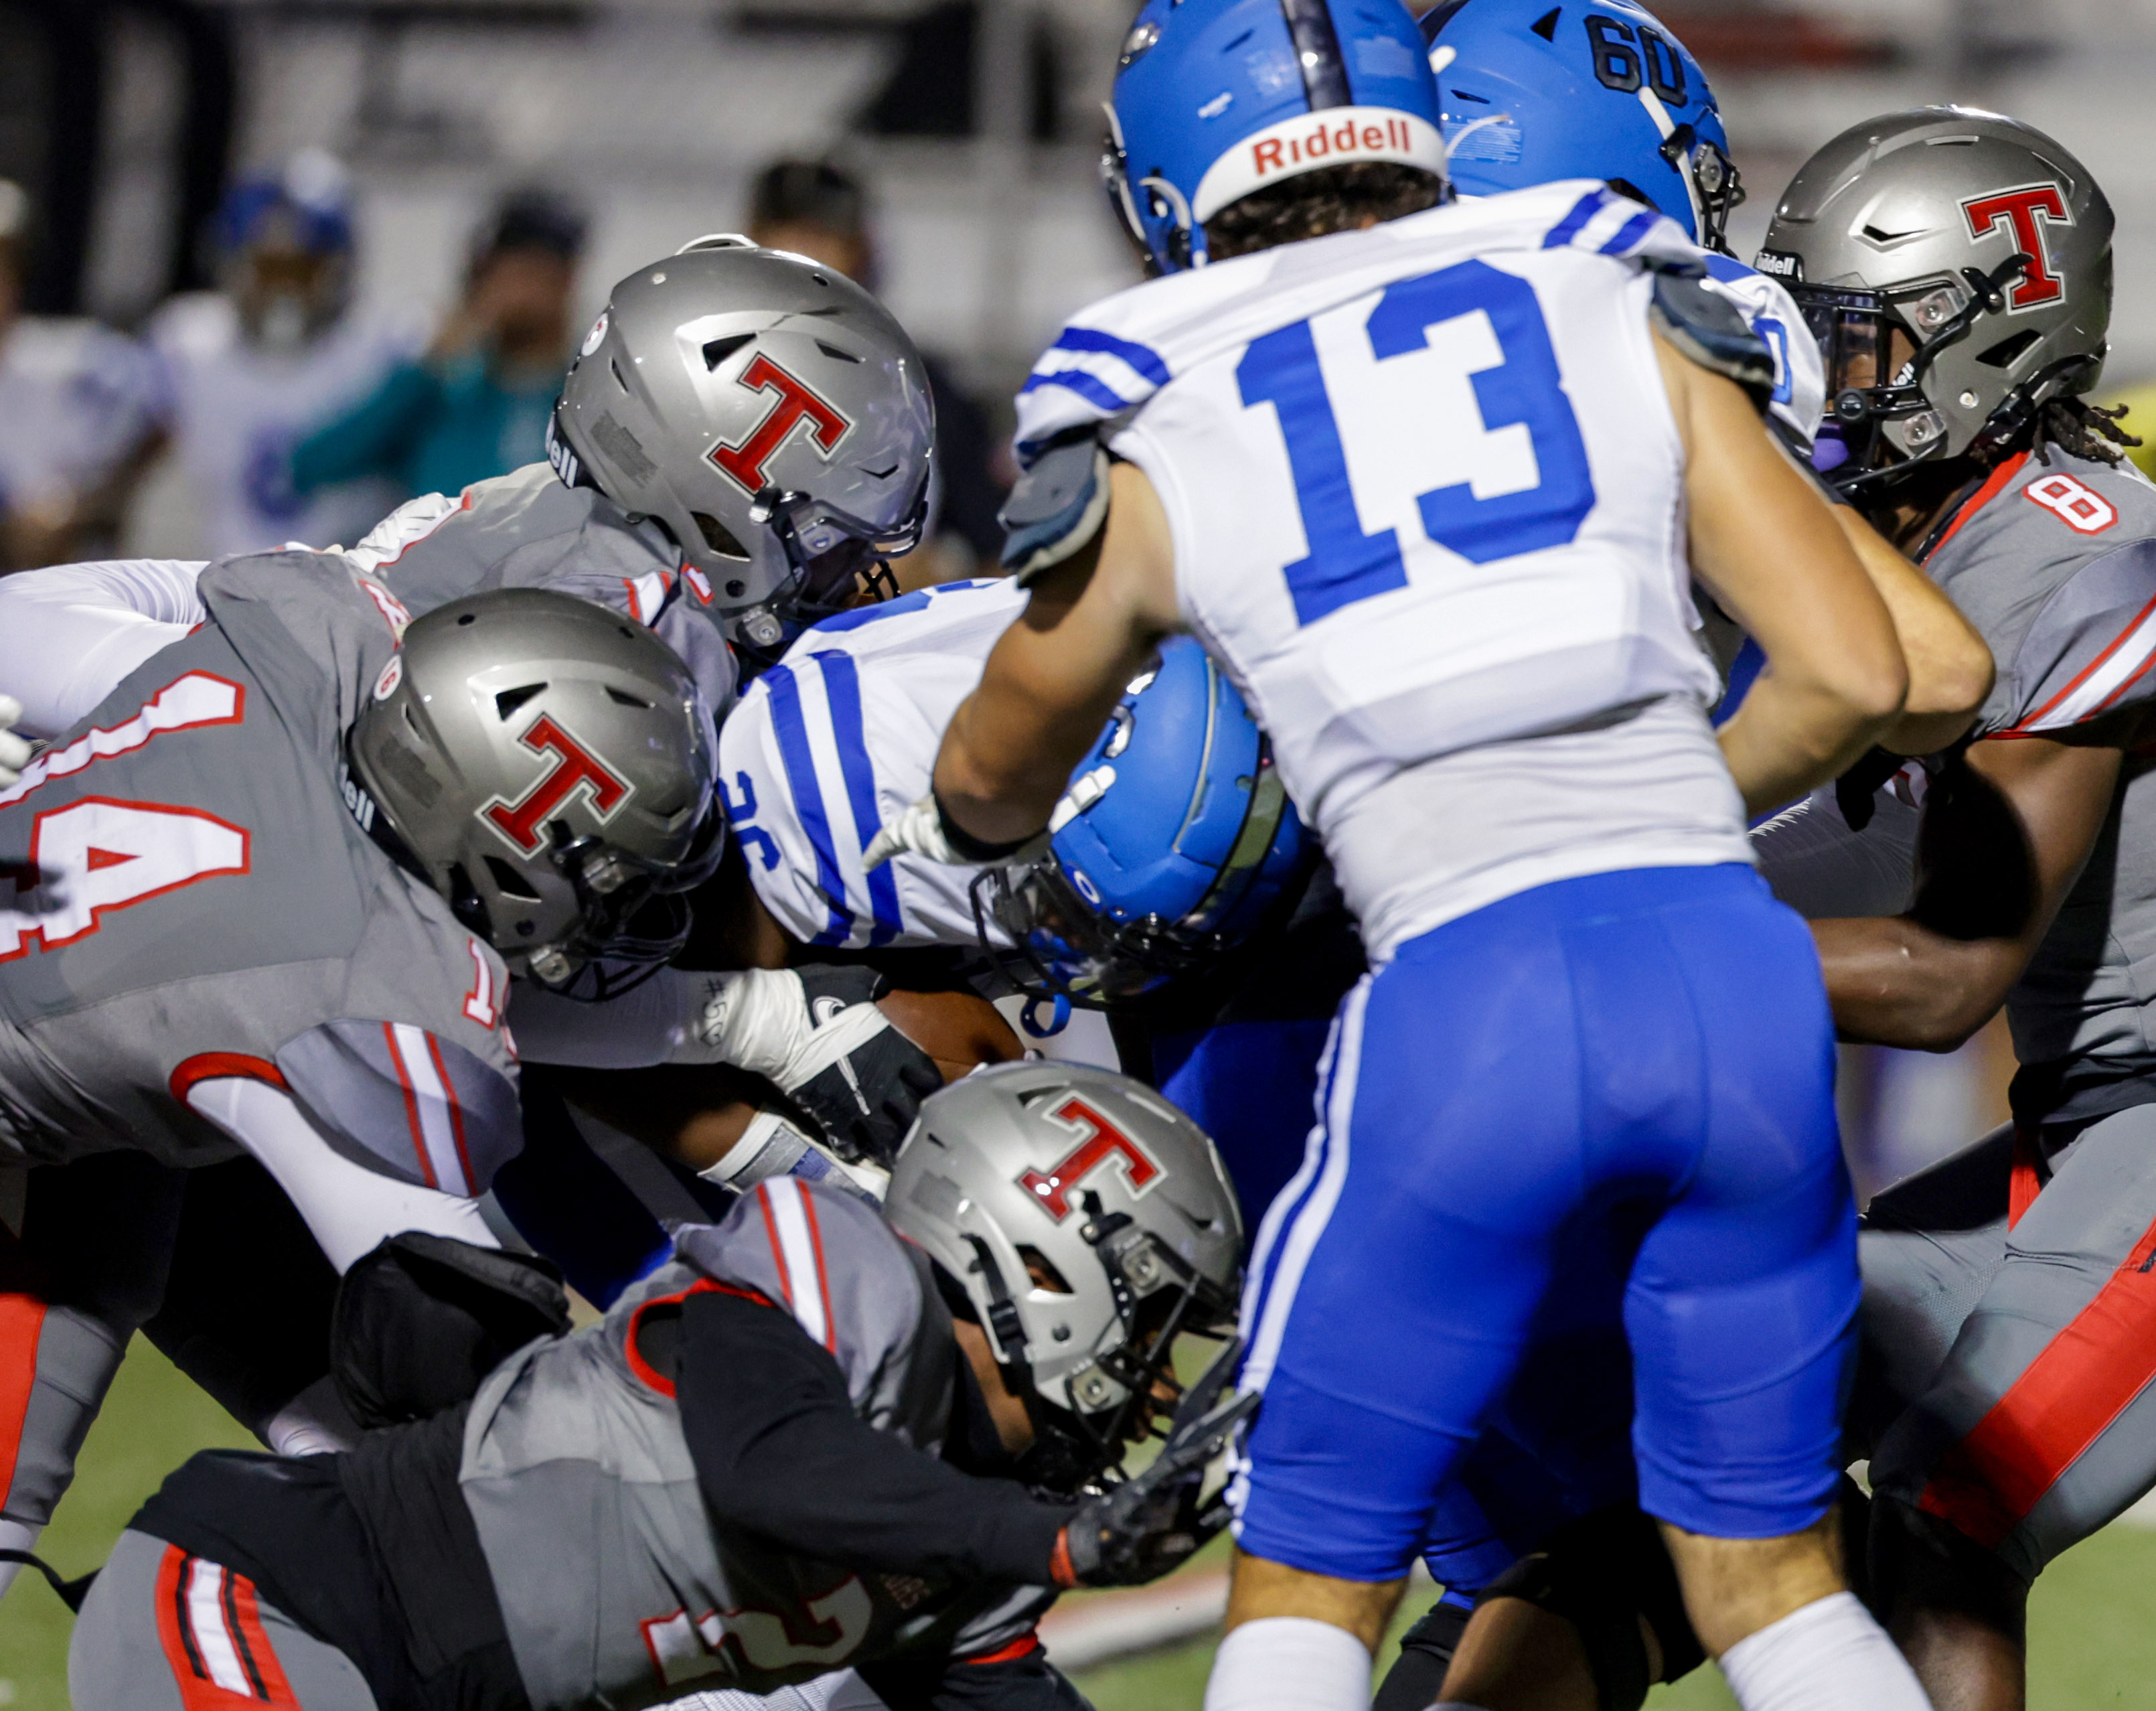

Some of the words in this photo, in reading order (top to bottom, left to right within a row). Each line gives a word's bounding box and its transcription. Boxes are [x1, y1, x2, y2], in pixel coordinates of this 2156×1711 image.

[1584, 14, 1688, 108] 60
[1253, 119, 1410, 175] Riddell
[1957, 181, 2076, 315] T
[701, 352, 857, 498] T
[1235, 258, 1596, 627] 13
[2022, 472, 2119, 535] 8
[475, 712, 636, 860] T
[1016, 1090, 1167, 1224] T
